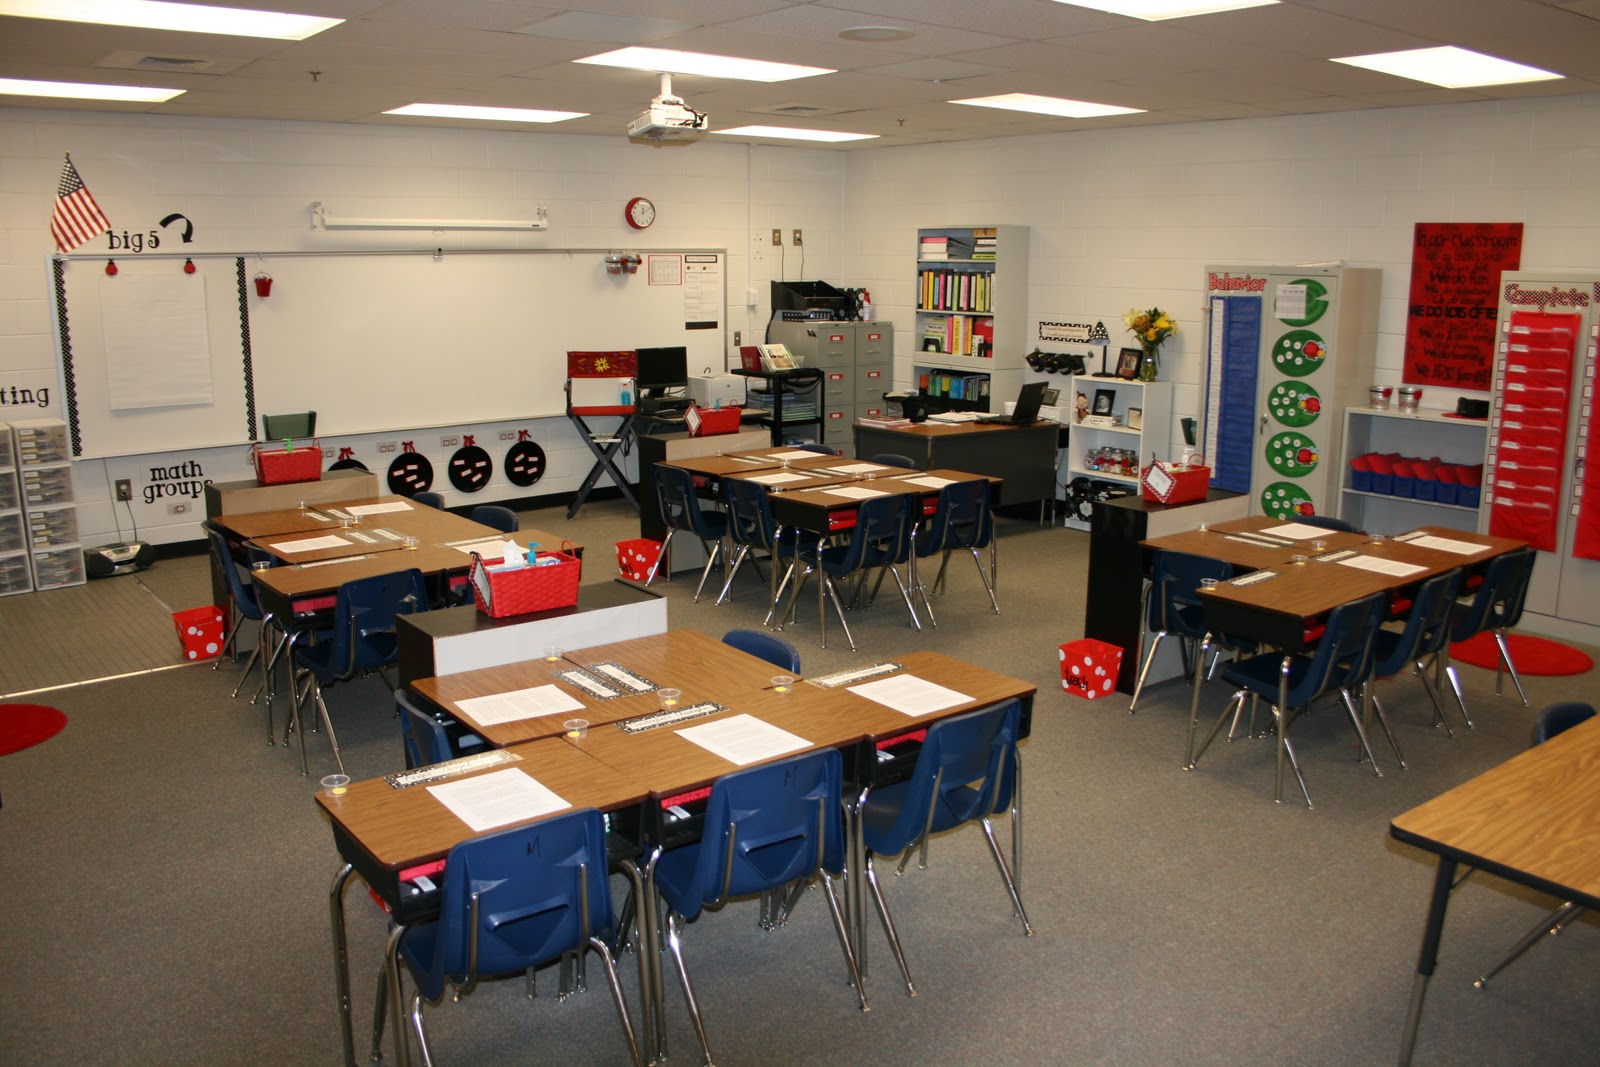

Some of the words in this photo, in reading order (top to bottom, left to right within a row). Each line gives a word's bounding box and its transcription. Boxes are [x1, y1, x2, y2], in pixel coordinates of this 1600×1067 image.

[106, 230, 143, 253] big
[148, 231, 160, 249] 5
[1208, 272, 1267, 292] Behavior
[1504, 283, 1590, 313] Complete
[0, 386, 49, 408] ting
[150, 460, 204, 481] math
